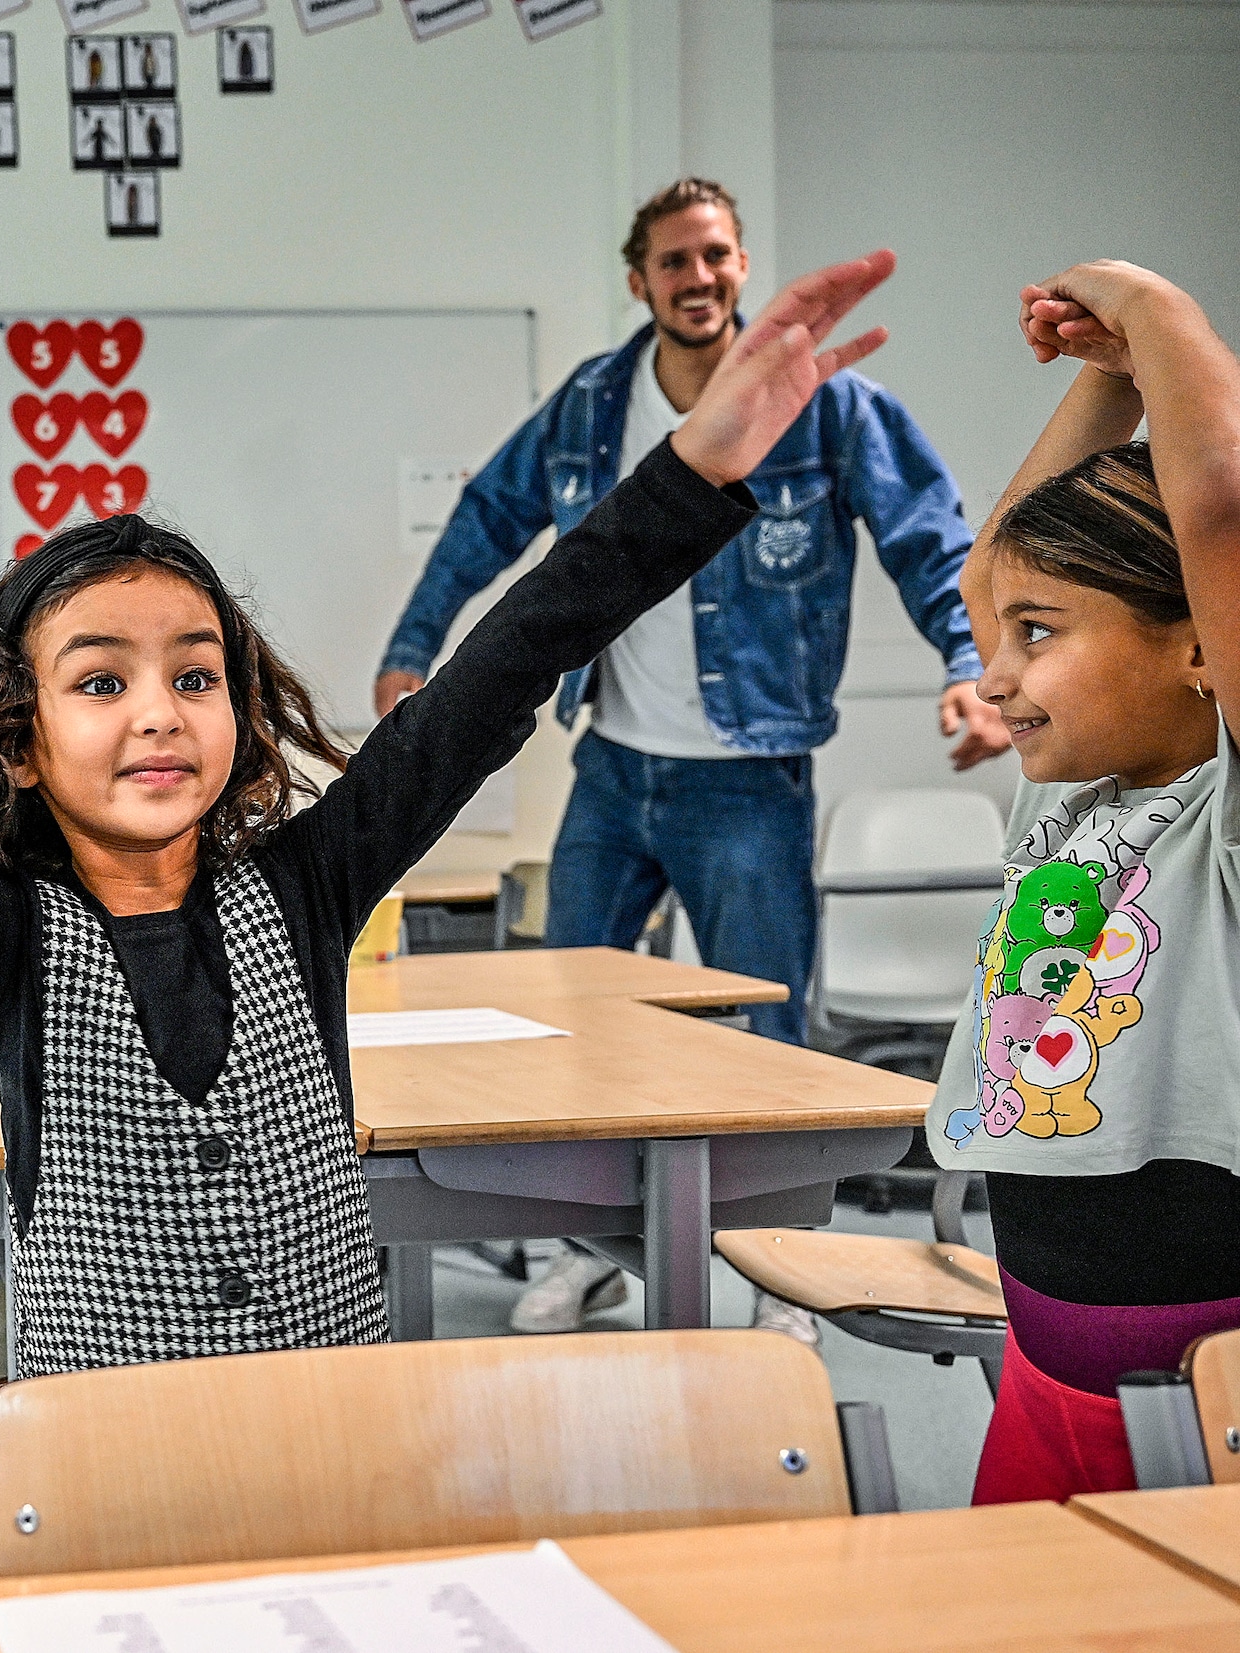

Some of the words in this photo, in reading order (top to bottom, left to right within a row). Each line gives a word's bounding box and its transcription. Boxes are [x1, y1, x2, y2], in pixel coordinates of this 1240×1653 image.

[31, 340, 52, 370] 5
[100, 339, 121, 369] 5
[34, 411, 59, 441] 6
[103, 410, 125, 439] 4
[36, 482, 59, 511] 7
[101, 482, 124, 511] 3
